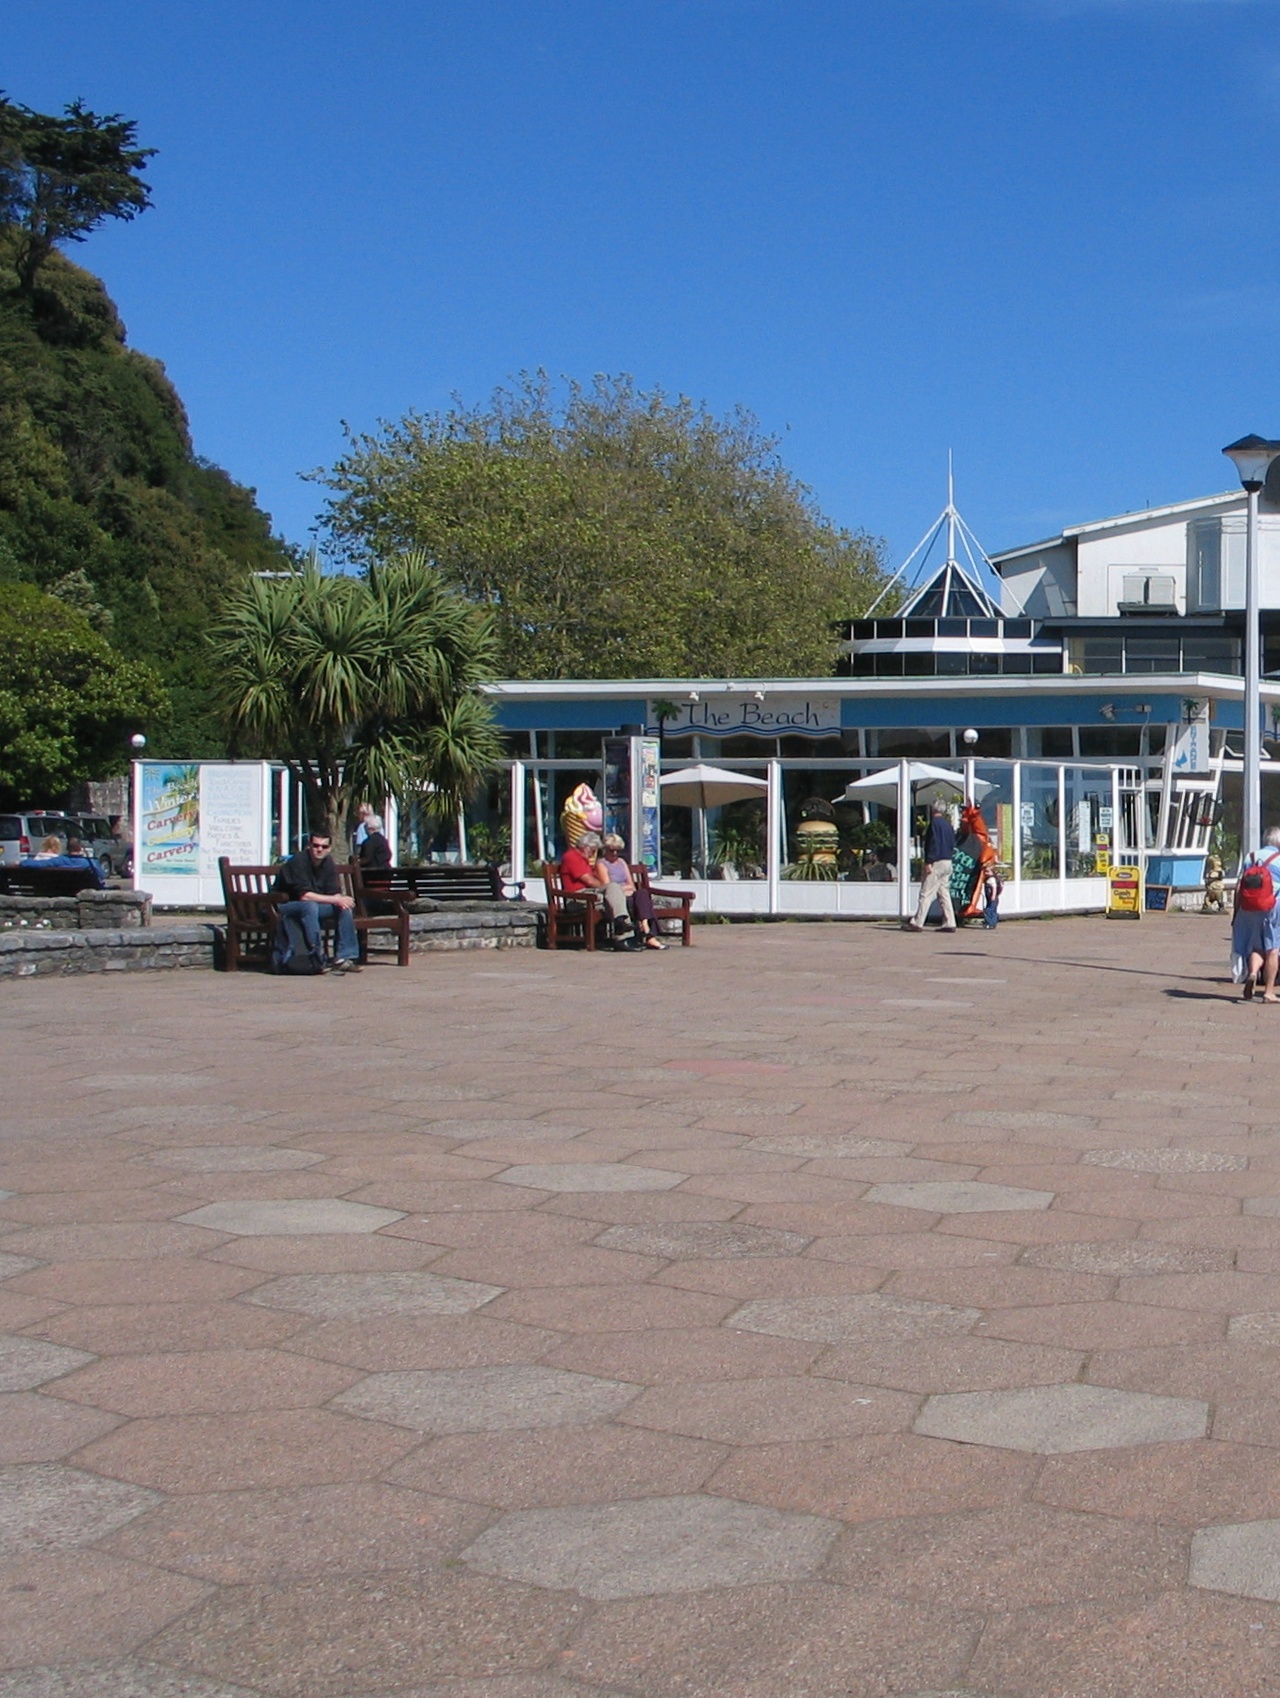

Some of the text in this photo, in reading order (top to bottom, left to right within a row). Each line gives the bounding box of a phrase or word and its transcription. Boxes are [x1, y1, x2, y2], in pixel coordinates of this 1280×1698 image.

[681, 702, 819, 726] The Beach
[147, 809, 198, 831] Carvery
[147, 842, 196, 862] Carvery
